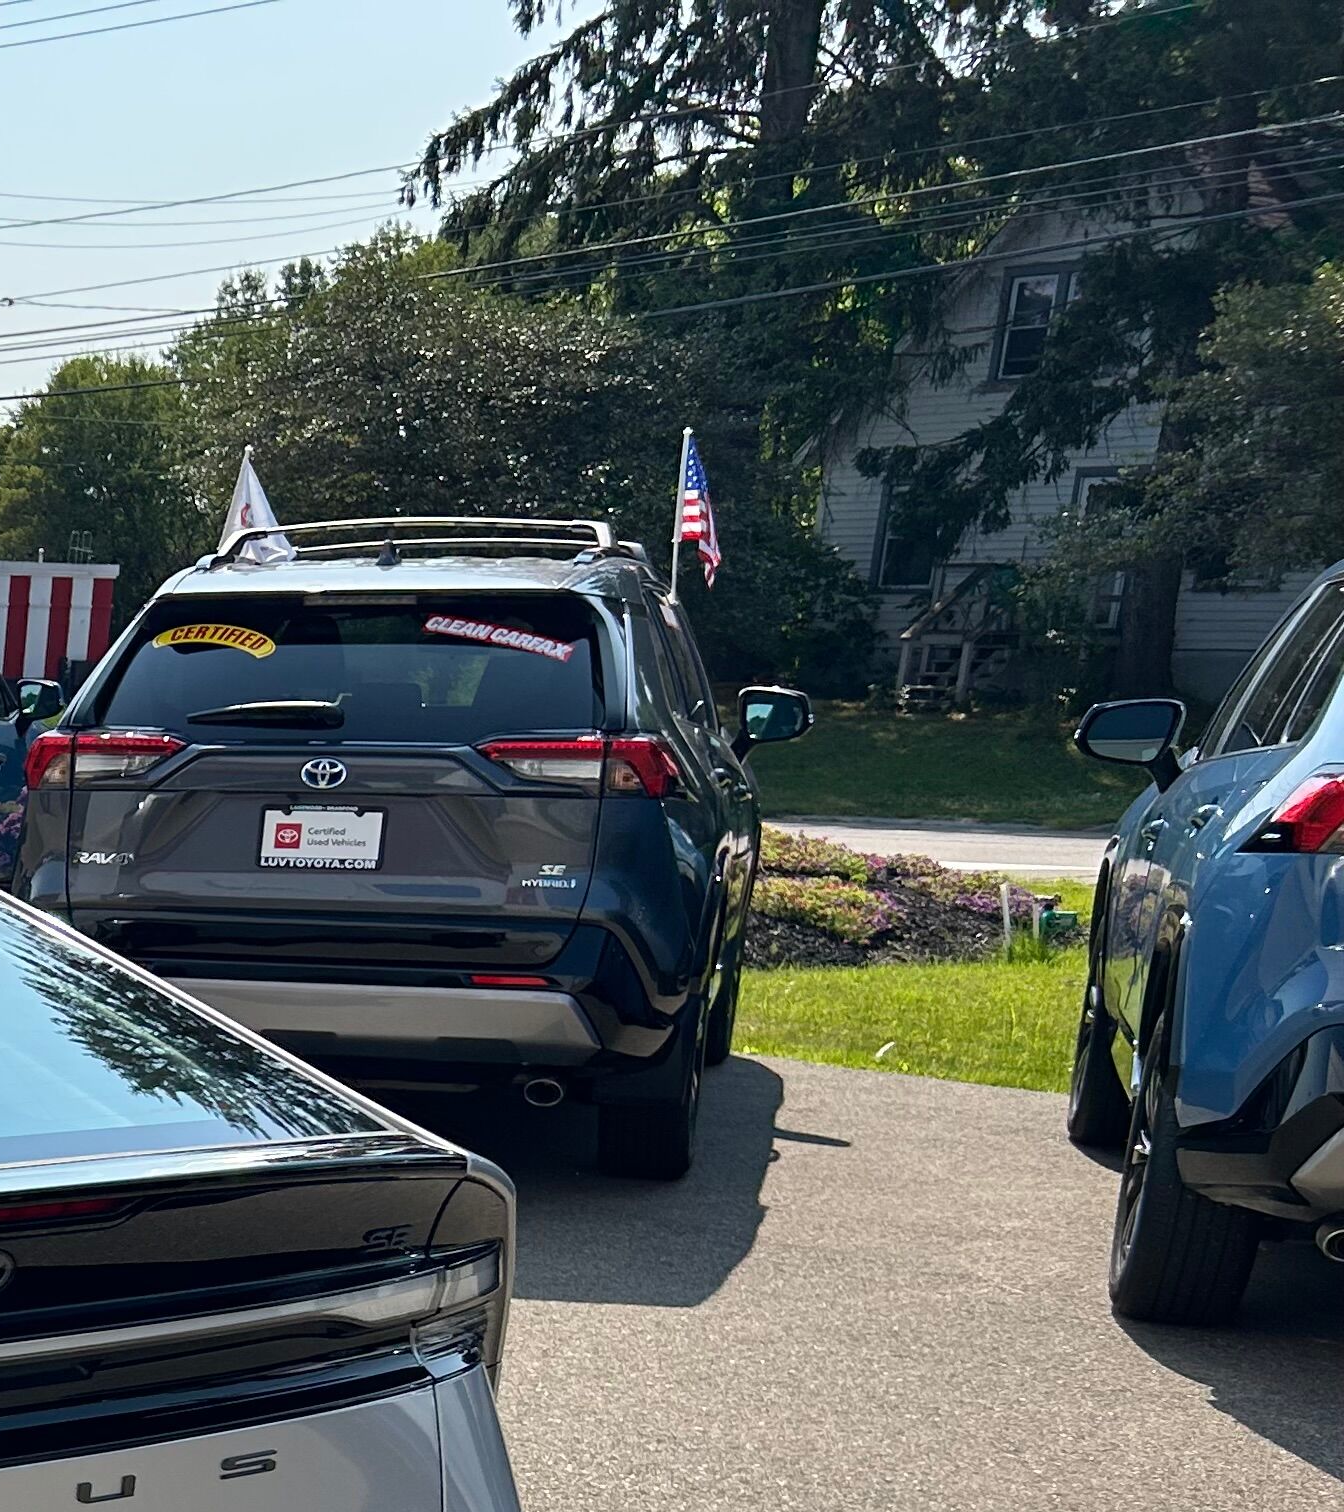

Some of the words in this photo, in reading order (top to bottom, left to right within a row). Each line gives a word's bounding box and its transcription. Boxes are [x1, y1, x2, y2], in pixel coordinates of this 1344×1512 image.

[170, 625, 269, 650] CERTIFIED
[425, 616, 494, 640] CLEAN
[490, 628, 574, 660] CARFAX
[308, 827, 346, 836] Certified
[307, 838, 329, 847] Used
[331, 838, 367, 847] Vehicles
[260, 857, 377, 869] LUVTOYOTA.COM
[538, 864, 566, 876] SE
[362, 1223, 415, 1252] SE
